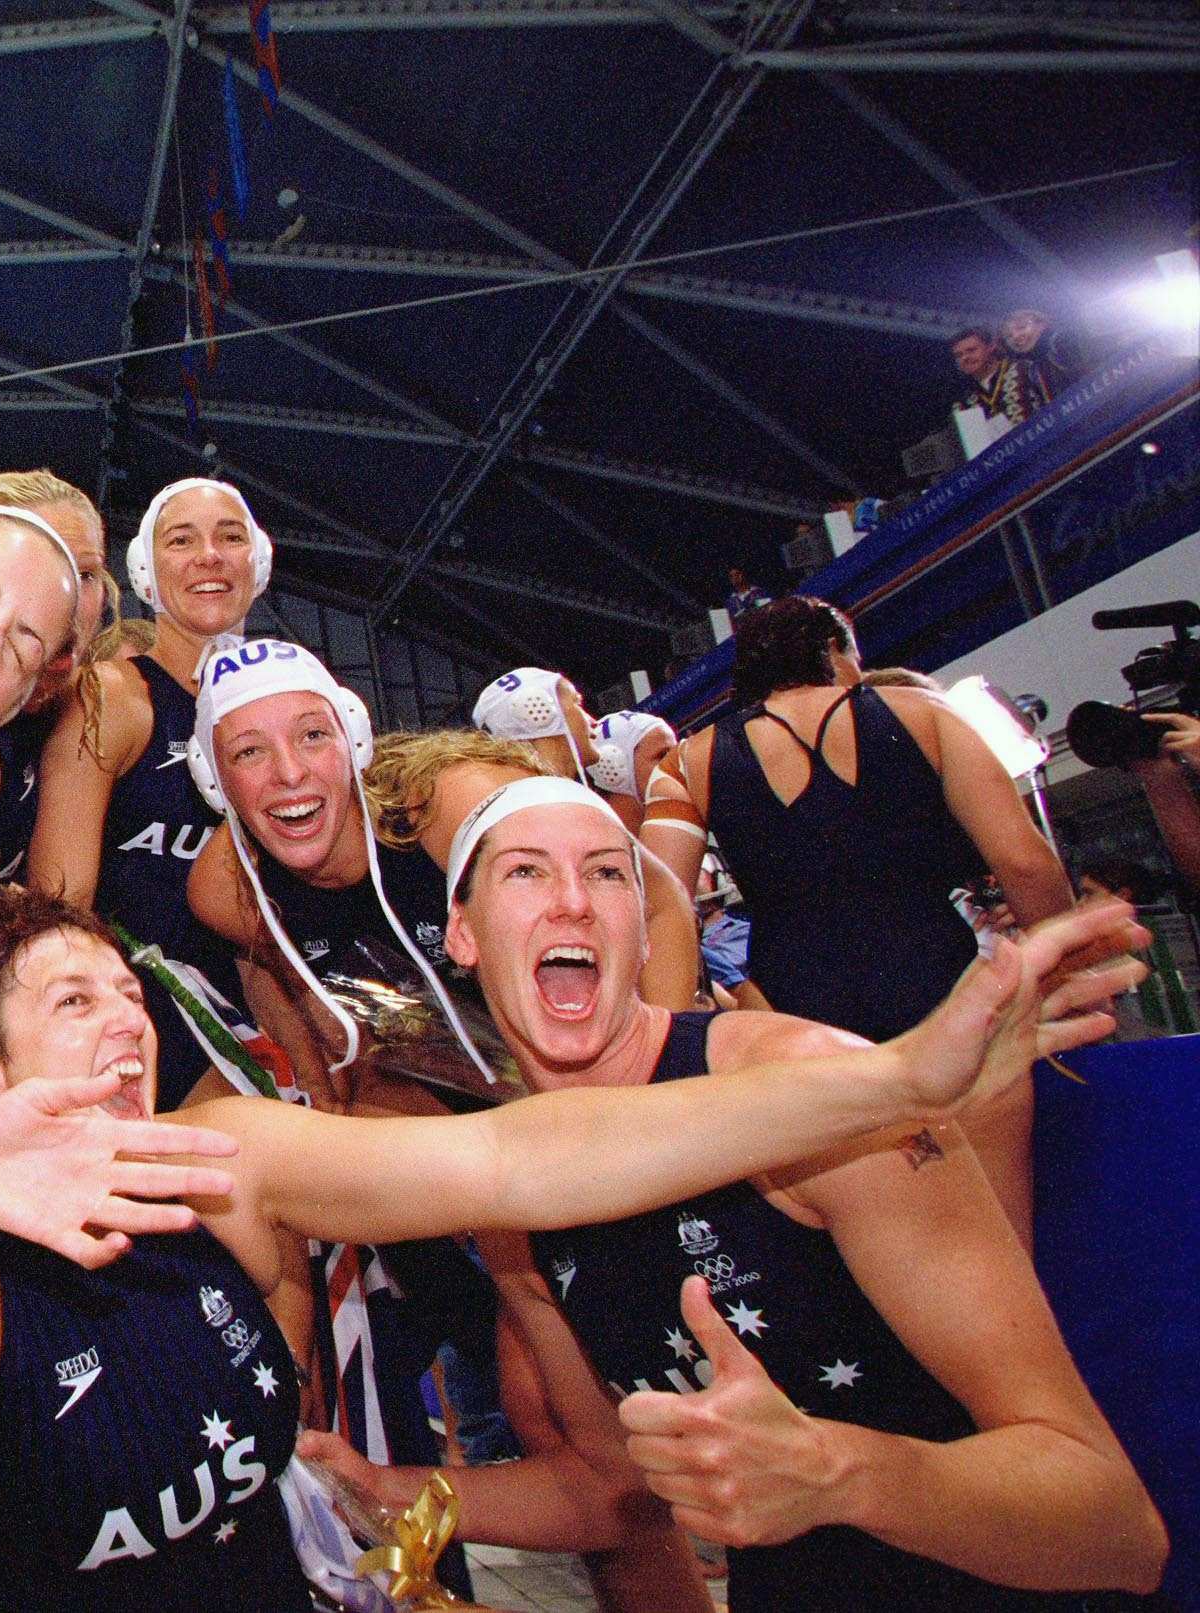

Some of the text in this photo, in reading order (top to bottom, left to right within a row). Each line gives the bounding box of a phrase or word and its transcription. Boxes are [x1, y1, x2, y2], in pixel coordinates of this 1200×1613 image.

[982, 414, 1055, 469] NOUVEAU
[211, 642, 298, 686] AUS
[117, 822, 216, 859] AU
[55, 1347, 99, 1380] SPEEDO
[78, 1435, 266, 1570] AUS
